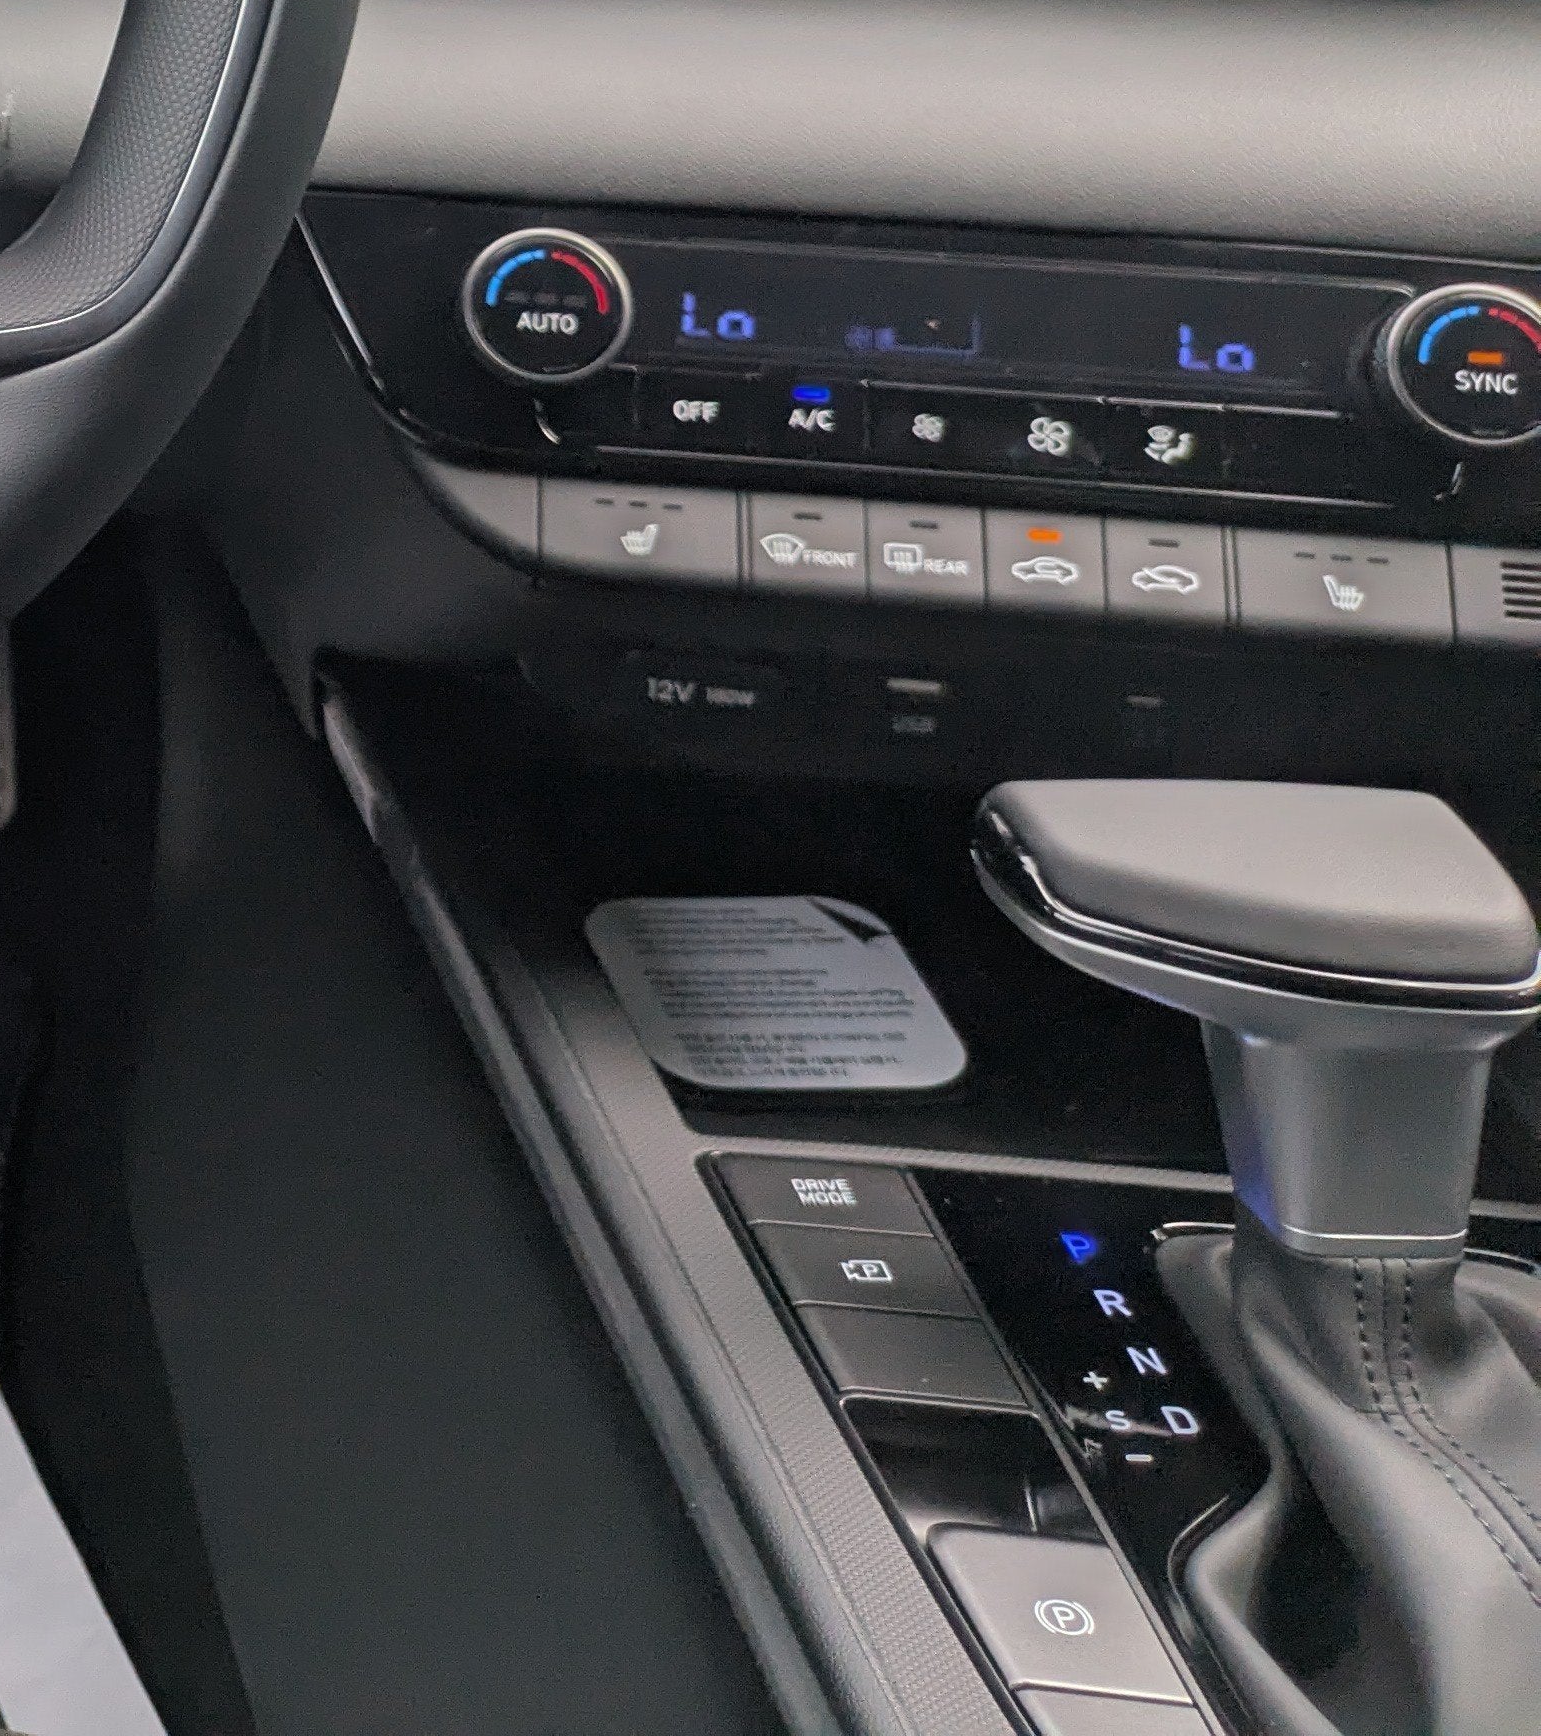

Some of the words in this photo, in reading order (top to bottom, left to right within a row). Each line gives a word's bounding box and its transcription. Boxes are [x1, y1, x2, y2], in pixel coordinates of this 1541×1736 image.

[516, 311, 579, 335] AUTO
[1454, 370, 1517, 395] SYNC
[673, 401, 718, 423] OFF
[789, 409, 834, 433] A/C
[802, 551, 857, 568] FRONT
[923, 558, 968, 577] REAR
[647, 676, 695, 703] 12V
[791, 1178, 850, 1192] DRIVE
[797, 1191, 858, 1206] MODE
[1060, 1231, 1097, 1263] P
[1093, 1288, 1132, 1318] R
[1126, 1347, 1167, 1375] N
[1106, 1410, 1132, 1432] S
[1160, 1405, 1199, 1435] D
